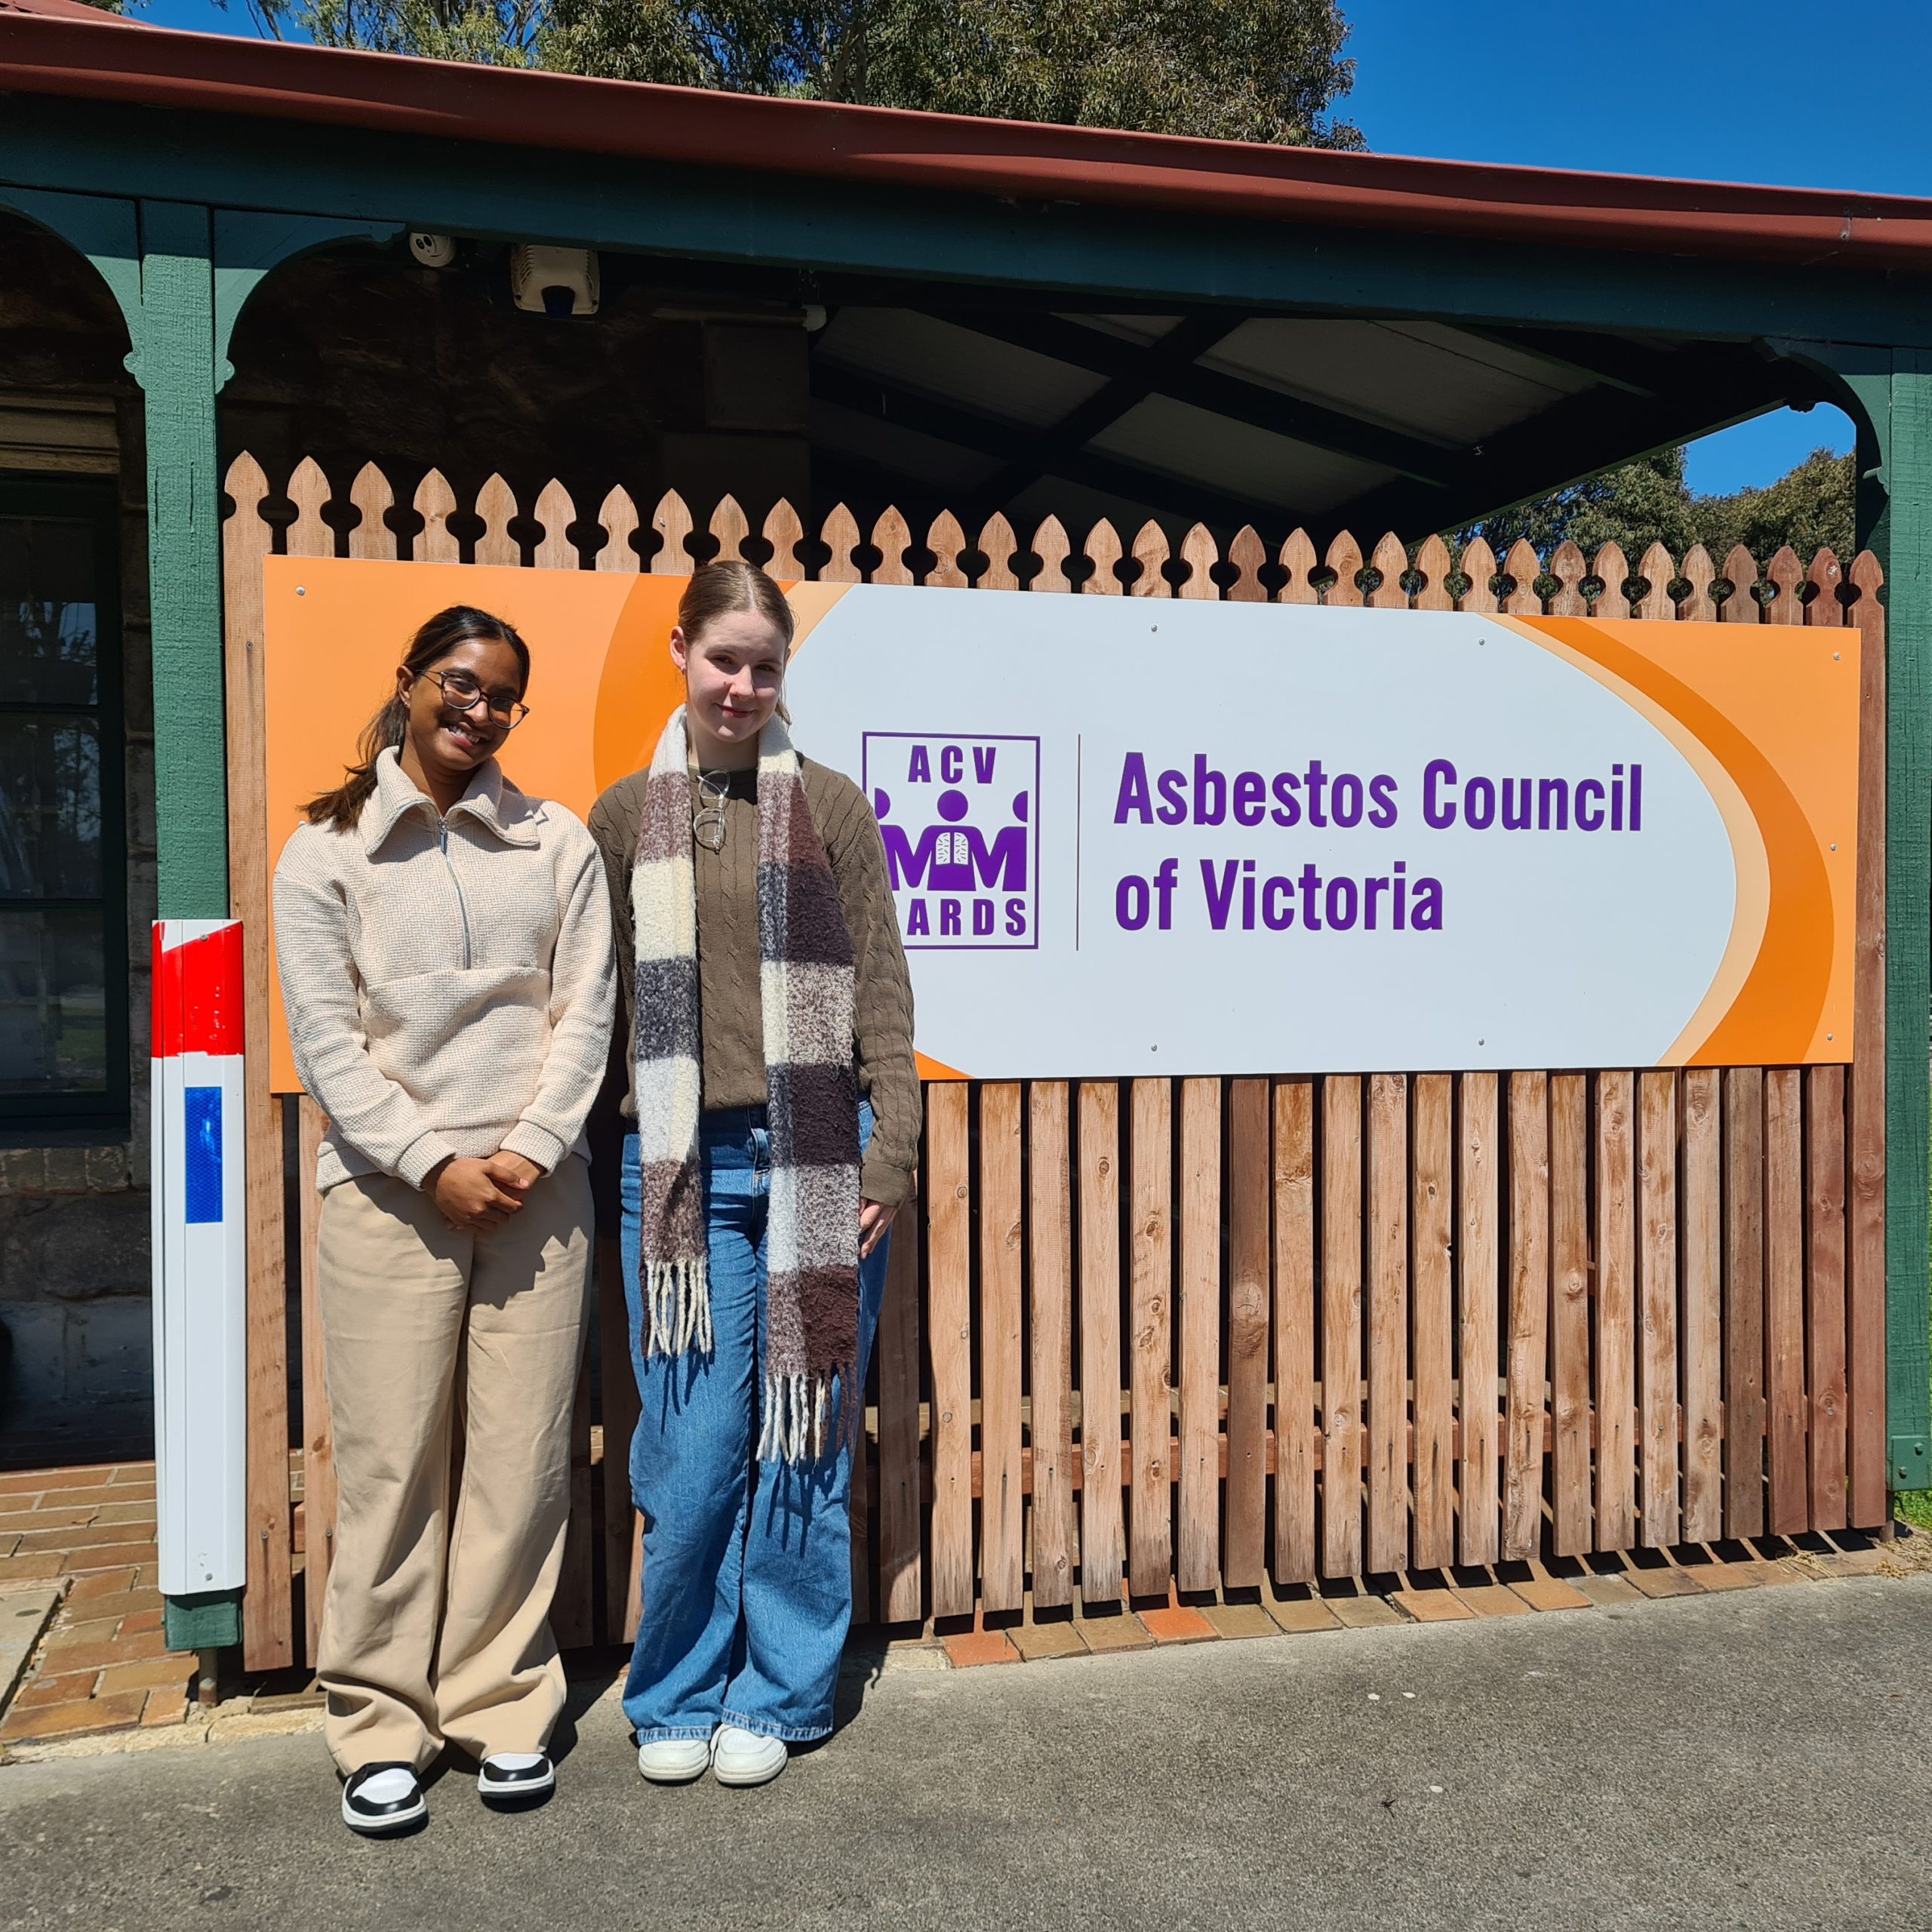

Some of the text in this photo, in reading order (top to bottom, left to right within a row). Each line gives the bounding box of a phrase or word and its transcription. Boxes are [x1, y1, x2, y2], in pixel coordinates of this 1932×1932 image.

[908, 745, 996, 784] ACV
[1115, 752, 1642, 832] Asbestos Council
[907, 898, 1026, 936] ARDS
[1116, 858, 1443, 931] of Victoria
